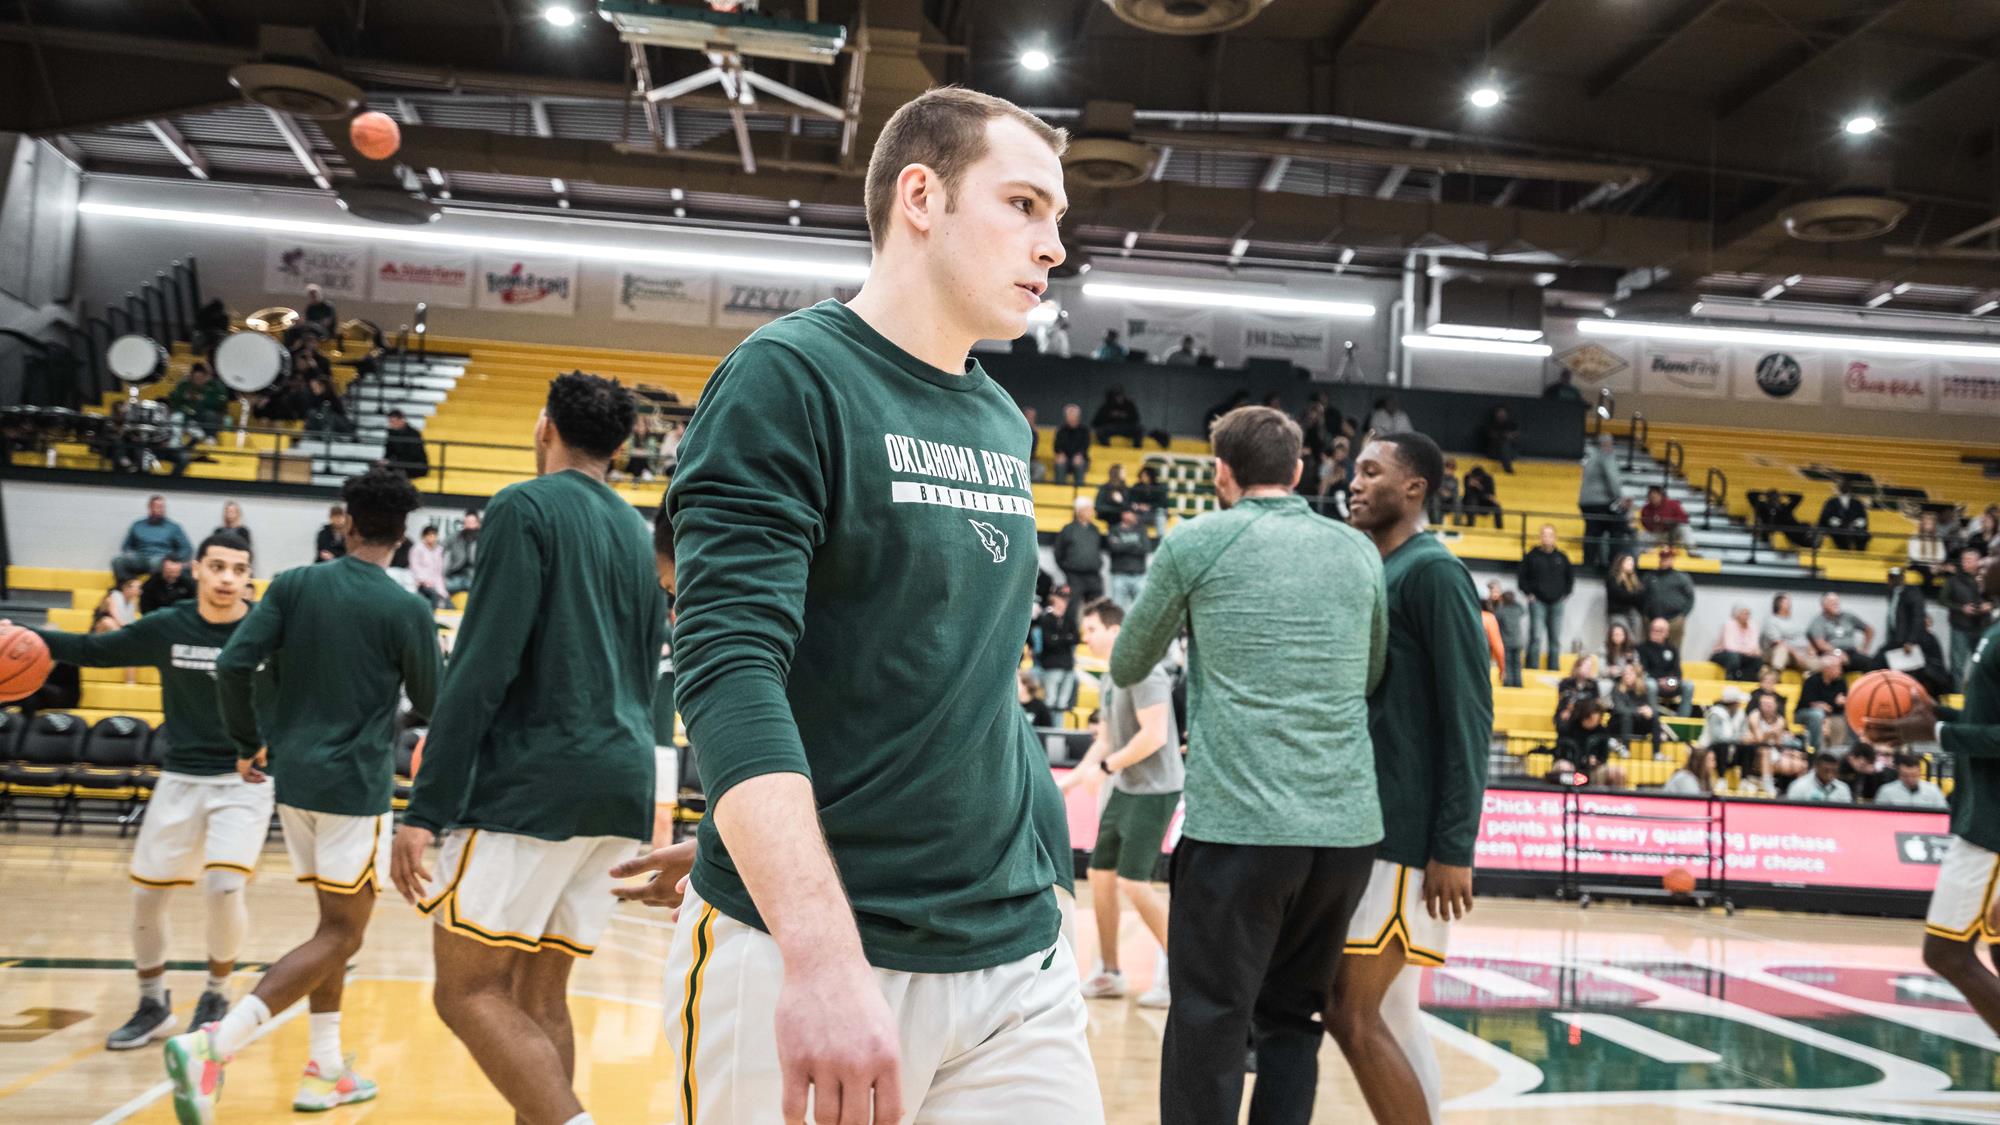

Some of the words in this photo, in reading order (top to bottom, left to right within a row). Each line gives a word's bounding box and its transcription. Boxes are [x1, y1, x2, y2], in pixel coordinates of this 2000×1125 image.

[884, 433, 983, 484] OKLAHOMA
[979, 449, 1033, 497] BAPTIS
[1487, 820, 1547, 838] points
[1552, 822, 1592, 840] with
[1595, 825, 1648, 846] every
